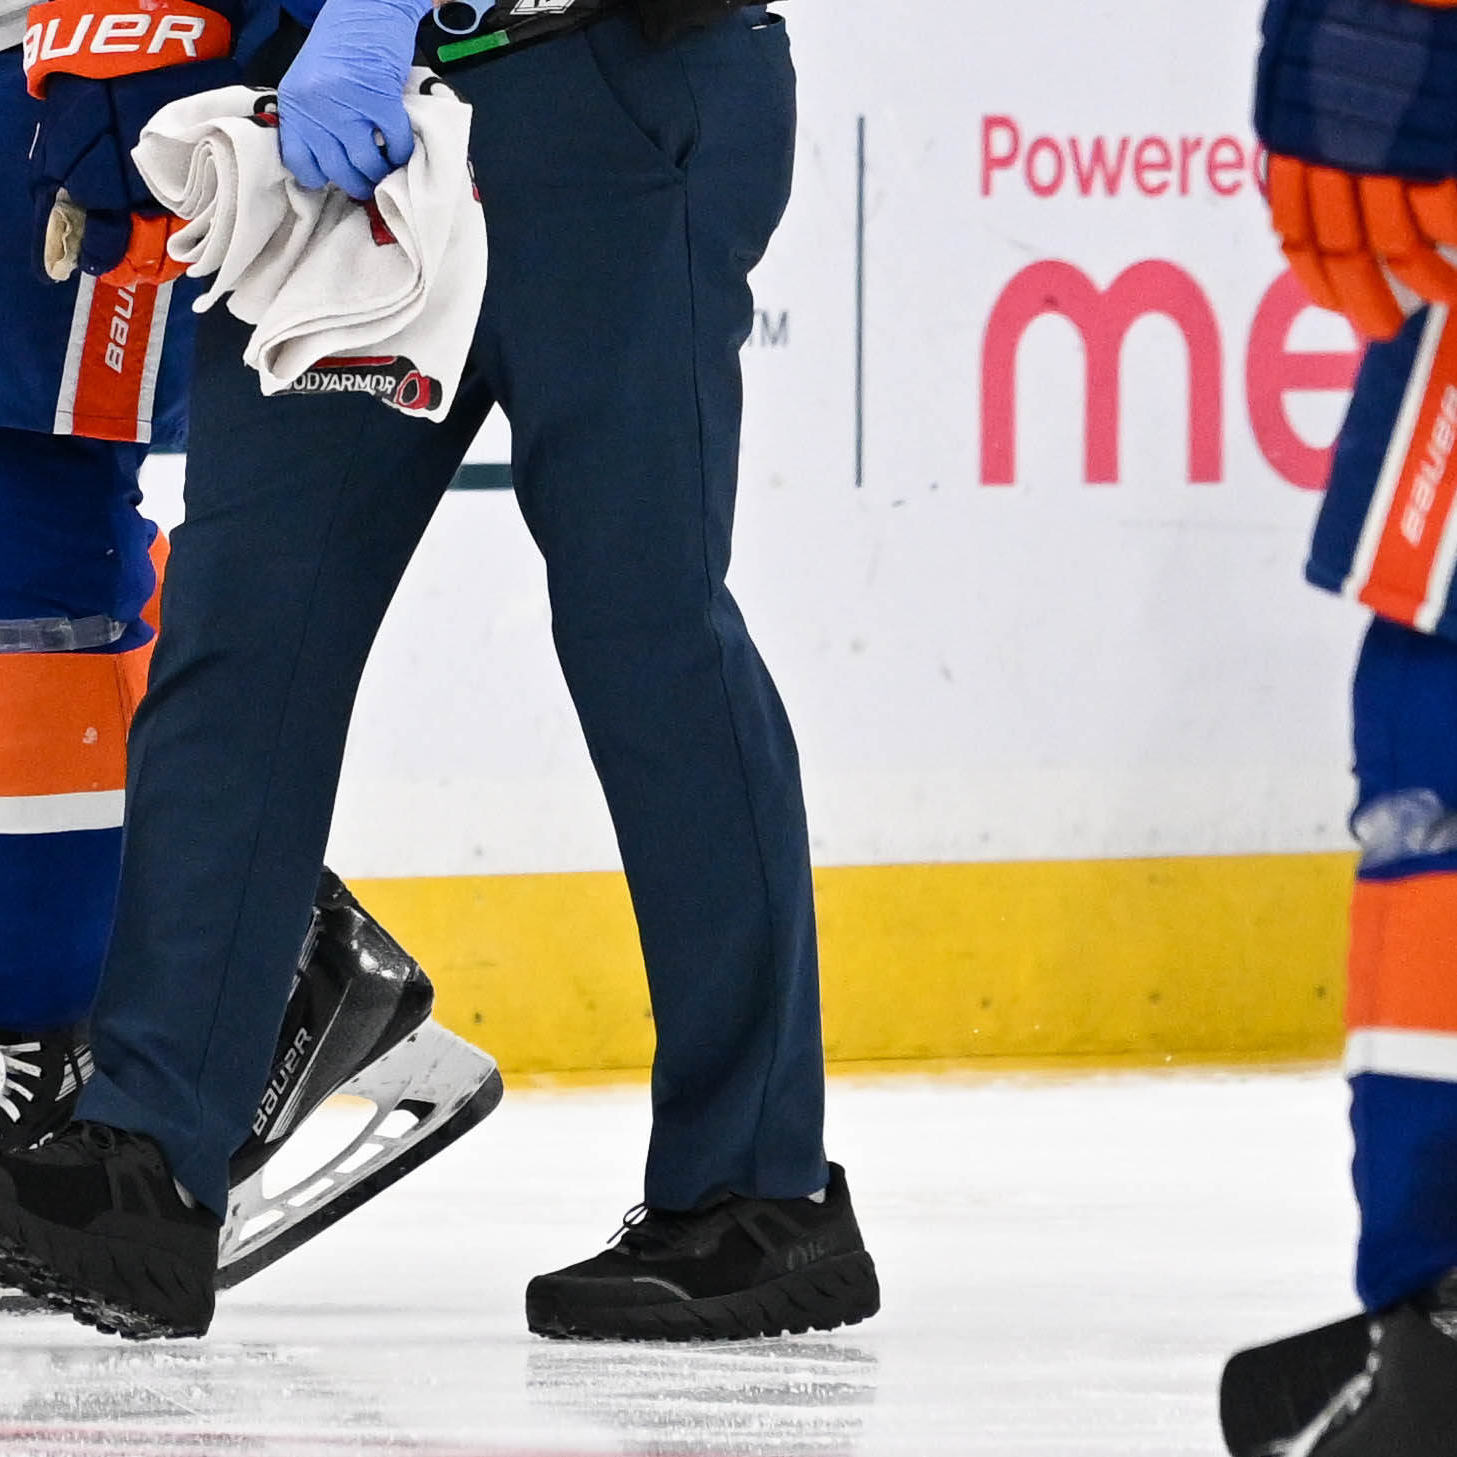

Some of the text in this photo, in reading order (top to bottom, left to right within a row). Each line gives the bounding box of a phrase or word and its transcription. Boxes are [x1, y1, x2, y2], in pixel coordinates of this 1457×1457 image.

[23, 11, 207, 80] AUER
[285, 371, 397, 396] ODYARMOR
[252, 1024, 314, 1138] BAUER
